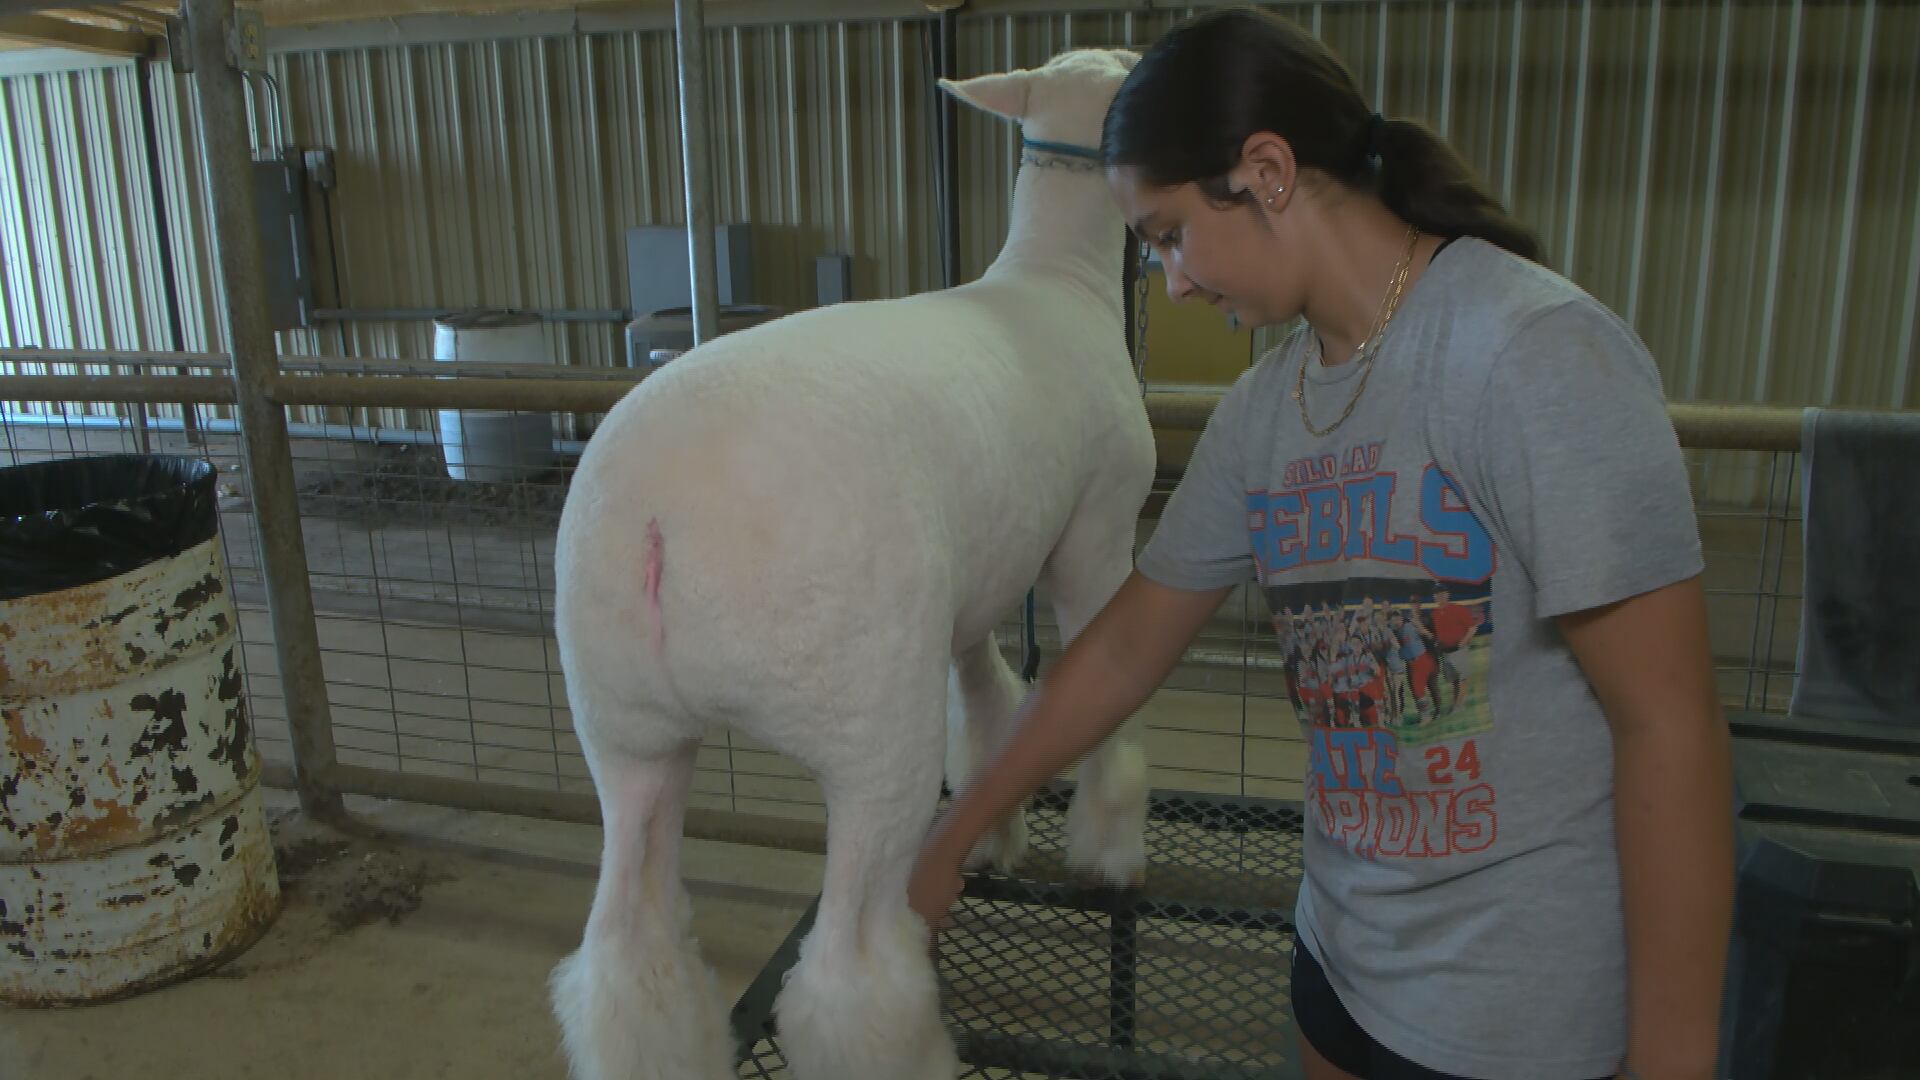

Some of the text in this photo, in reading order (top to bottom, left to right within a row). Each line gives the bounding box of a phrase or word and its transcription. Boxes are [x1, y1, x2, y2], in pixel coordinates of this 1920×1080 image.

[1312, 726, 1481, 798] ATE 24
[1316, 783, 1497, 862] PIONS
